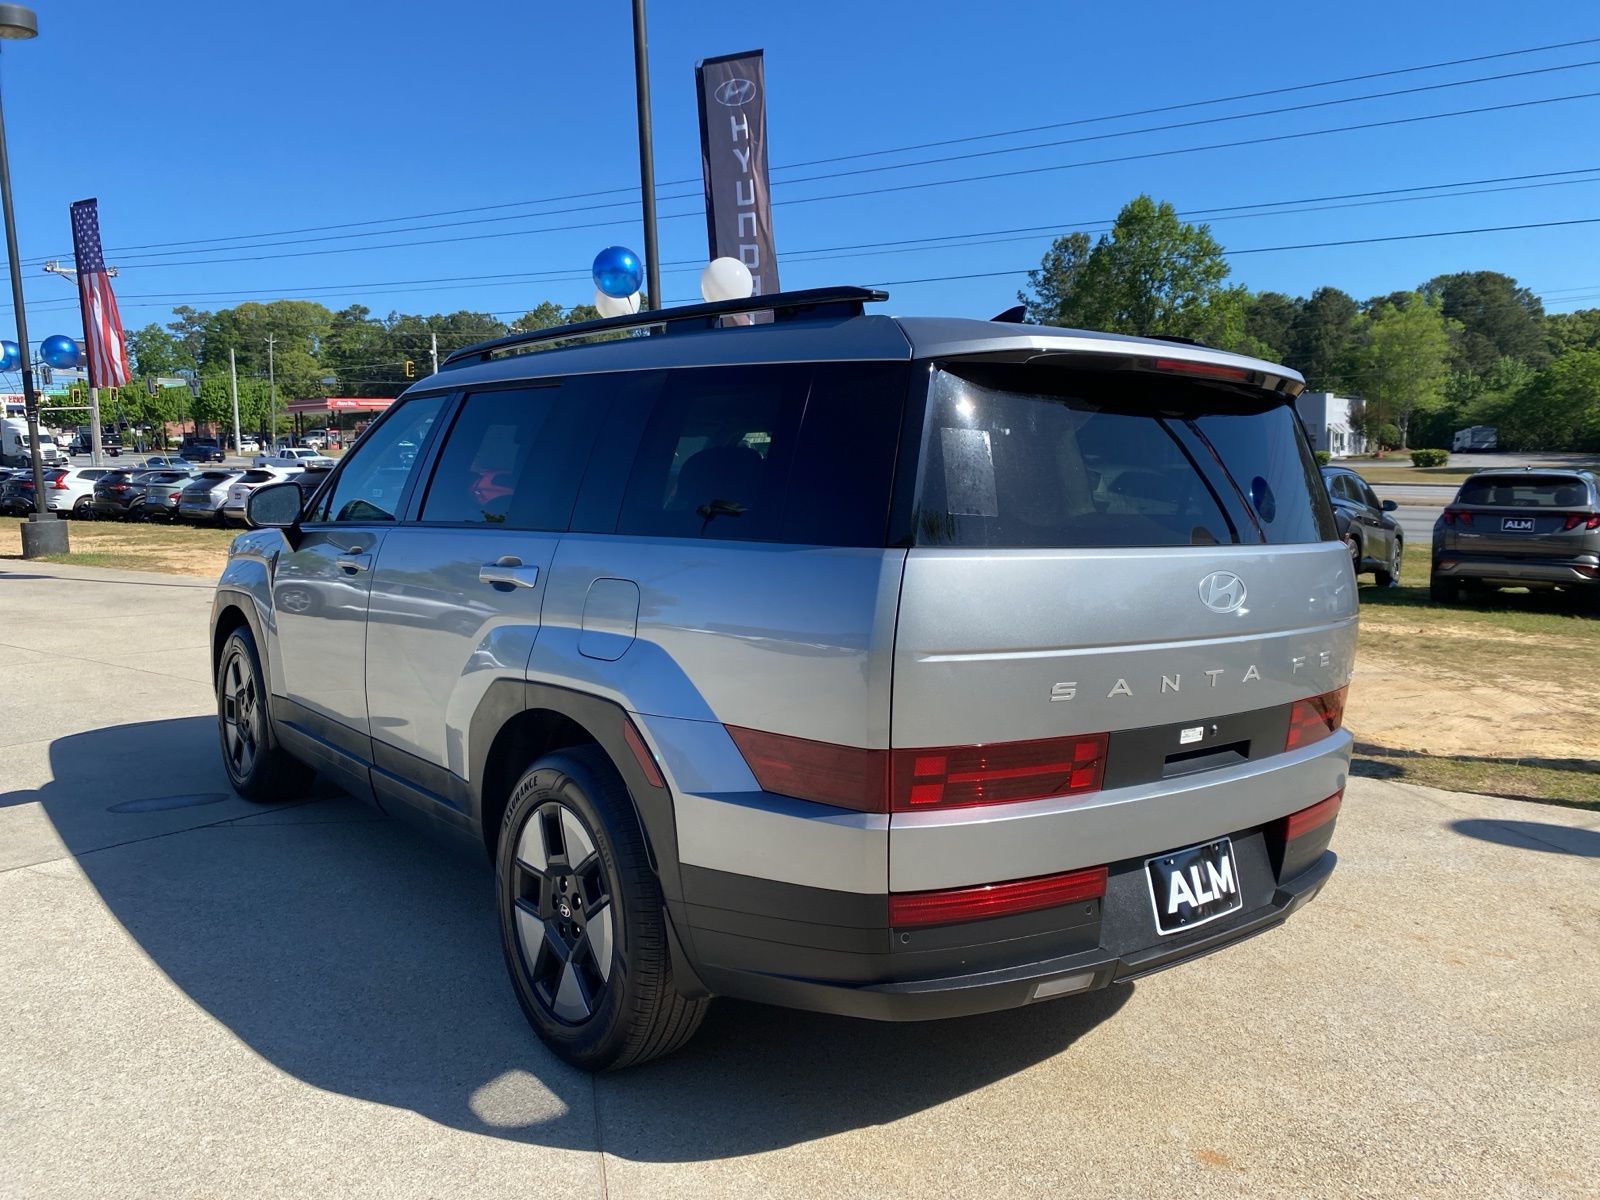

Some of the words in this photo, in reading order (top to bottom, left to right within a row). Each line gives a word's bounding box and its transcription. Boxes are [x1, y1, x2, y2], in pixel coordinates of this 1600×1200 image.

[1504, 520, 1532, 530] ALM
[1050, 664, 1261, 702] SANTA
[1292, 651, 1331, 674] FE
[1168, 855, 1236, 914] ALM
